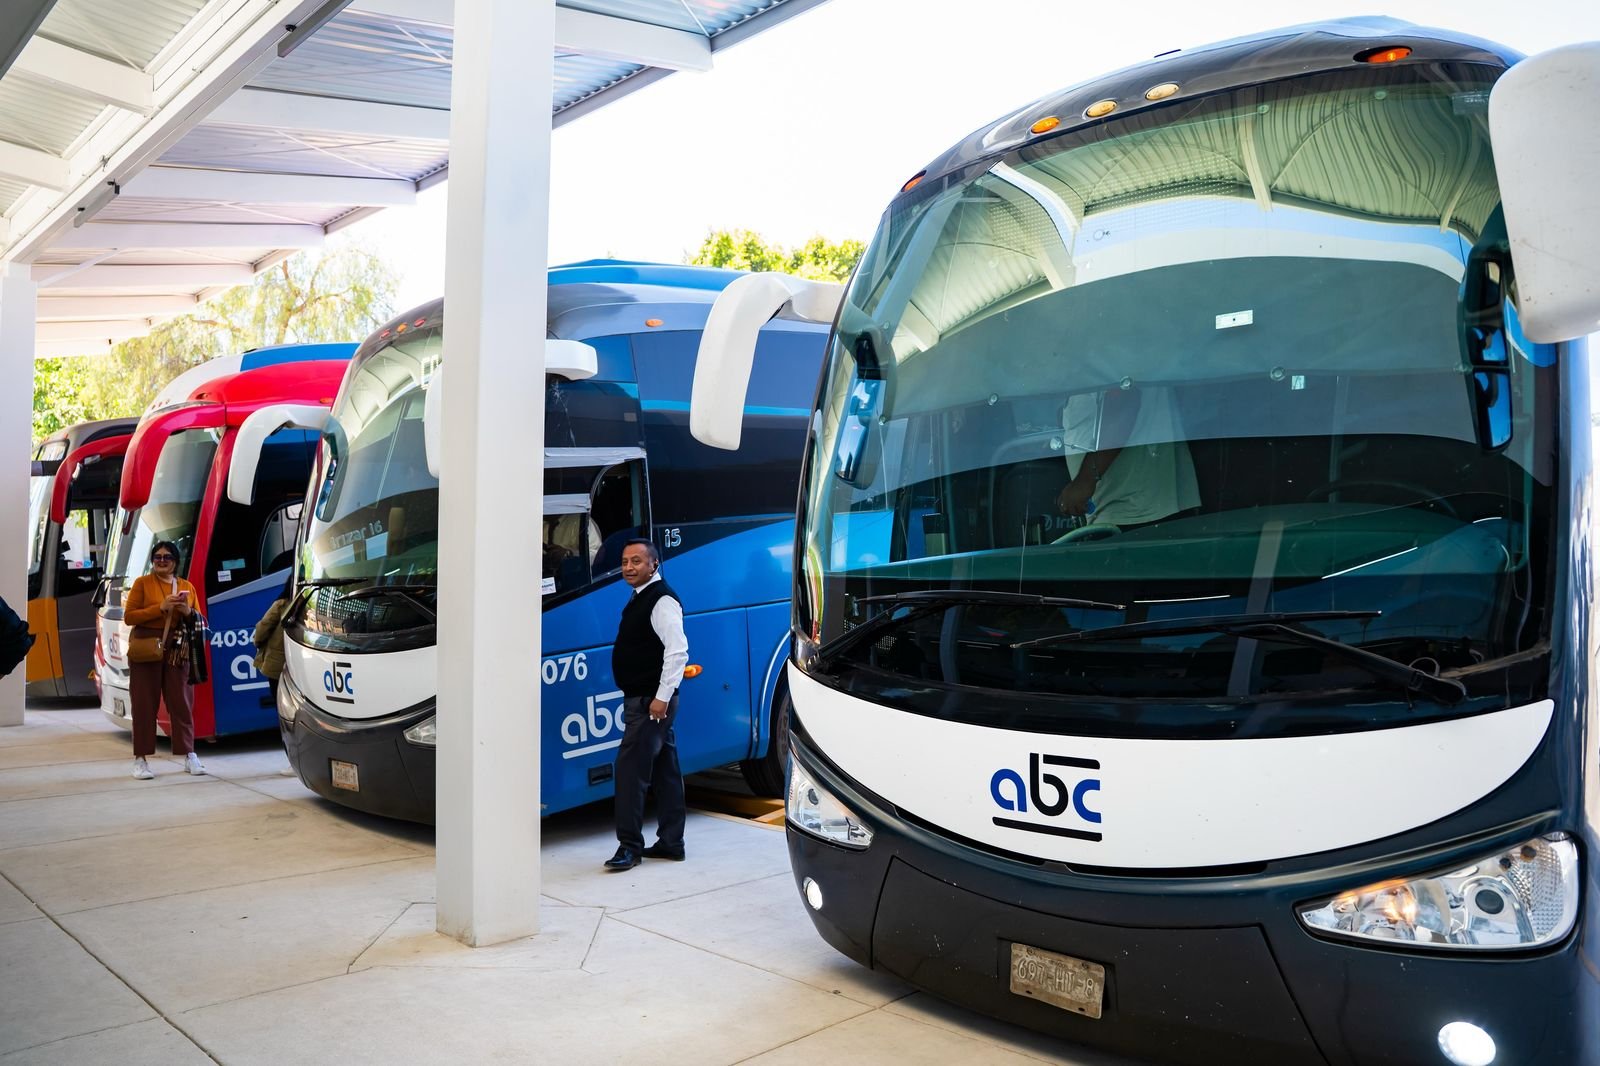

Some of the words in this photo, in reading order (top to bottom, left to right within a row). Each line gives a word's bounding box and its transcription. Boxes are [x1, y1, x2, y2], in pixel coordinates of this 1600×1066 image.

[664, 528, 682, 547] i5
[324, 661, 354, 695] abc
[990, 752, 1102, 824] abc
